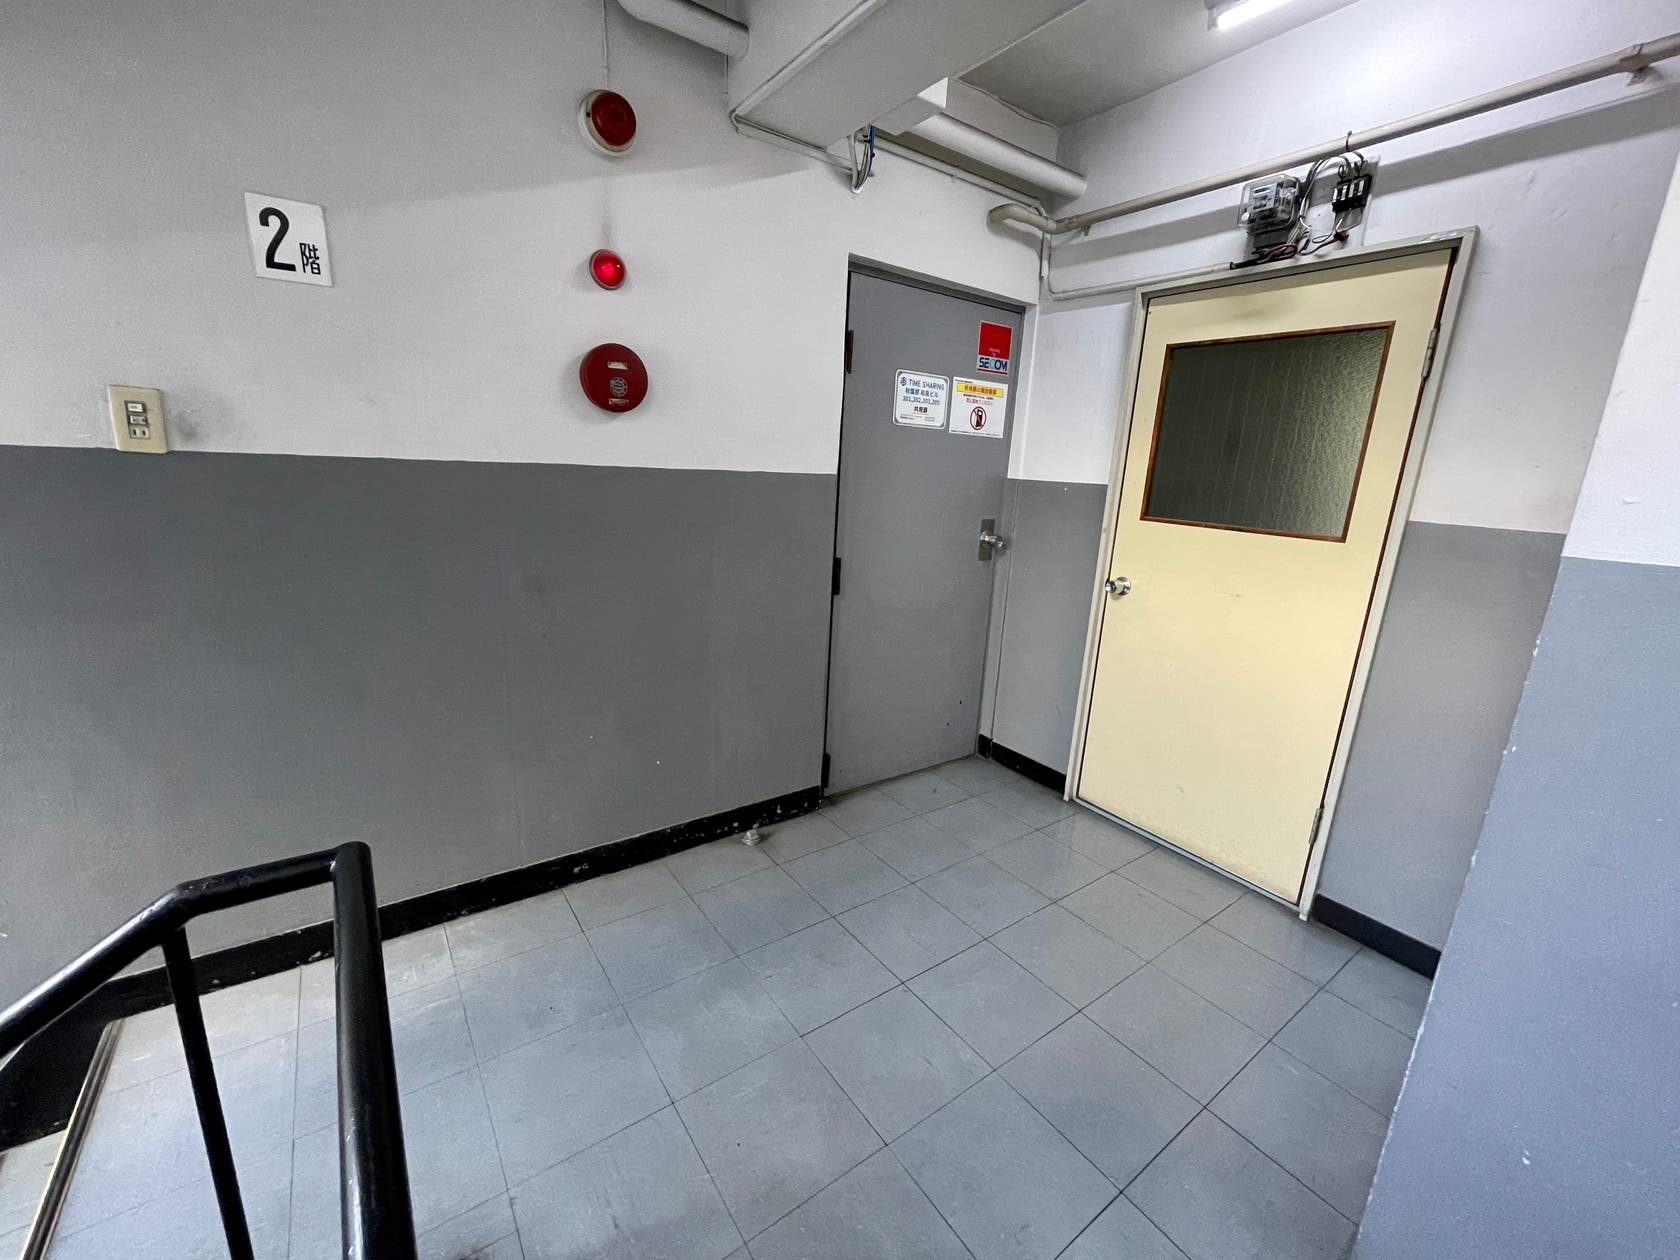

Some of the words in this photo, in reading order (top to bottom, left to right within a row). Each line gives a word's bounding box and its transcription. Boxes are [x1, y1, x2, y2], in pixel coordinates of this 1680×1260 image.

[259, 207, 321, 275] 2階
[979, 357, 1008, 371] SECOM
[909, 379, 921, 388] TIME
[923, 381, 945, 391] SHARING
